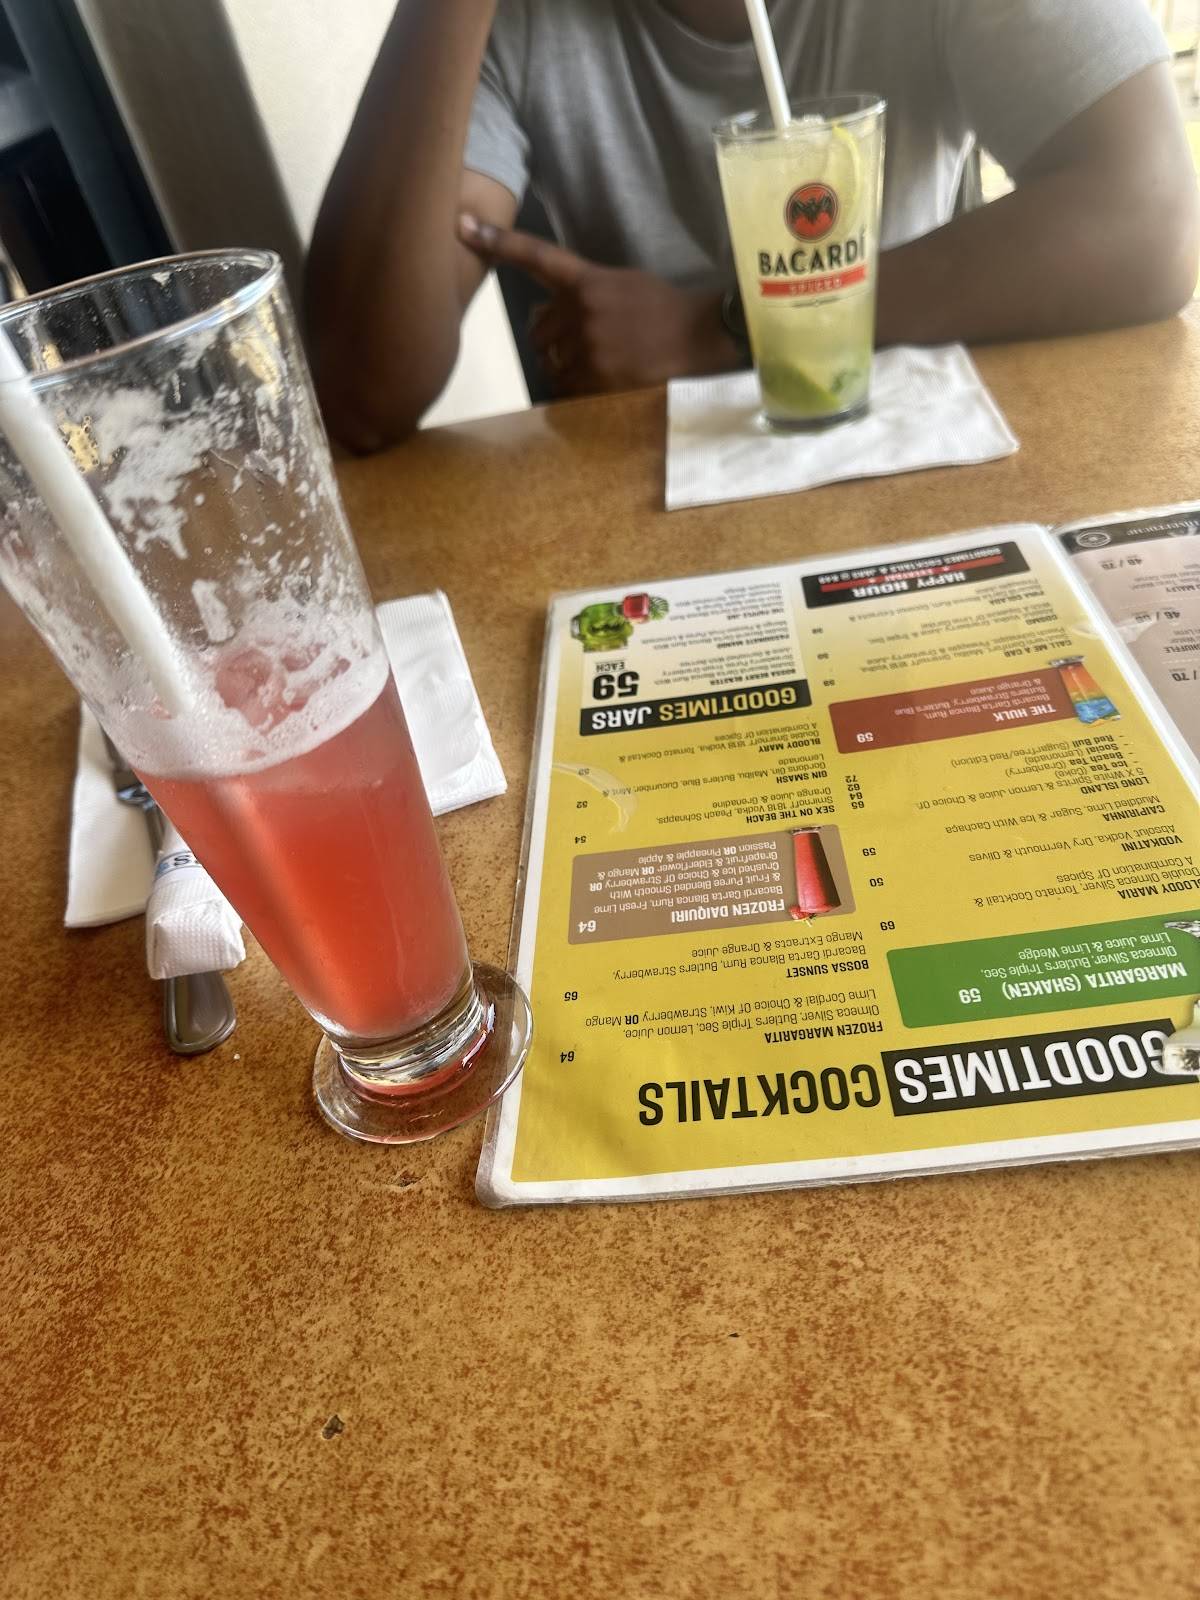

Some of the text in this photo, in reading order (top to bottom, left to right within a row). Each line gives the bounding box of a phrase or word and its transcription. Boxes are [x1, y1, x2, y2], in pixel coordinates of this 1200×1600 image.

[758, 224, 865, 276] BACARDÍ
[917, 572, 965, 588] HAPPY
[852, 581, 908, 596] HOUR
[596, 661, 624, 672] EACH
[1171, 672, 1189, 682] 70
[592, 671, 639, 701] 59
[592, 688, 796, 729] GOODTIMES JARS
[993, 704, 1056, 721] THE HULK
[759, 738, 820, 752] BLOODY MARY
[776, 770, 827, 783] GIN SMASH
[845, 775, 858, 783] 72
[1055, 766, 1087, 779] (Coke)
[1080, 776, 1149, 794] LONG ISLAND
[851, 801, 864, 809] 65
[1114, 795, 1160, 809] Muddled
[746, 805, 834, 823] SEX ON THE BEACH
[1050, 808, 1083, 818] Sugar
[1102, 805, 1165, 821] CAIPIRINHA
[945, 822, 991, 833] Cachaça
[992, 817, 1018, 827] With
[1133, 825, 1174, 837] Absolut
[575, 836, 586, 844] 54
[1073, 837, 1094, 846] Dry
[1121, 835, 1183, 851] VODKATINI
[638, 841, 776, 864] Passion OR Pineapple & Apple
[862, 848, 876, 856] 59
[969, 851, 1000, 861] Olives
[1002, 849, 1012, 858] &
[1014, 841, 1071, 856] Vermouth
[597, 852, 777, 880] Grapefruit & Elderflower OR Mango &
[1161, 867, 1200, 879] Double
[590, 862, 779, 891] Crushed Ice & Choice Of Strawberry OR
[870, 878, 883, 887] 50
[1116, 873, 1160, 885] Olmeca
[610, 872, 780, 899] & Fruit Puree Blended Smooth With
[1035, 885, 1078, 897] Tomato
[594, 886, 783, 913] Bacardi Carta Blanca Rum, Fresh Lime
[973, 898, 983, 906] &
[986, 891, 1033, 905] Cocktail
[672, 899, 784, 922] FROZEN DAIQUIRI
[578, 920, 596, 933] 64
[880, 921, 895, 930] 69
[692, 931, 862, 958] Mango Extracts & Orange Juice
[1018, 932, 1171, 960] Lime Juice & Lime Wedge
[613, 945, 866, 980] Bacardi Carta Blanca Rum, Butlers Strawberry,
[787, 960, 869, 978] BOSSA SUNSET
[981, 946, 1177, 978] Olmeca Silver, Butlers Triple Sec,
[1002, 962, 1187, 998] MARGARITA (SHAKEN)
[564, 991, 577, 1001] 65
[959, 988, 981, 1003] 59
[586, 989, 876, 1026] Lime Cordial & Choice Of Kiwi, Strawberry OR Mango
[624, 1004, 879, 1039] Olmeca Silver, Butlers Triple Sec, Lemon Juice,
[764, 1021, 883, 1043] FROZEN MARGARITA
[560, 1051, 574, 1063] 64
[638, 1030, 1163, 1127] GOODTIMES COCKTAILS
